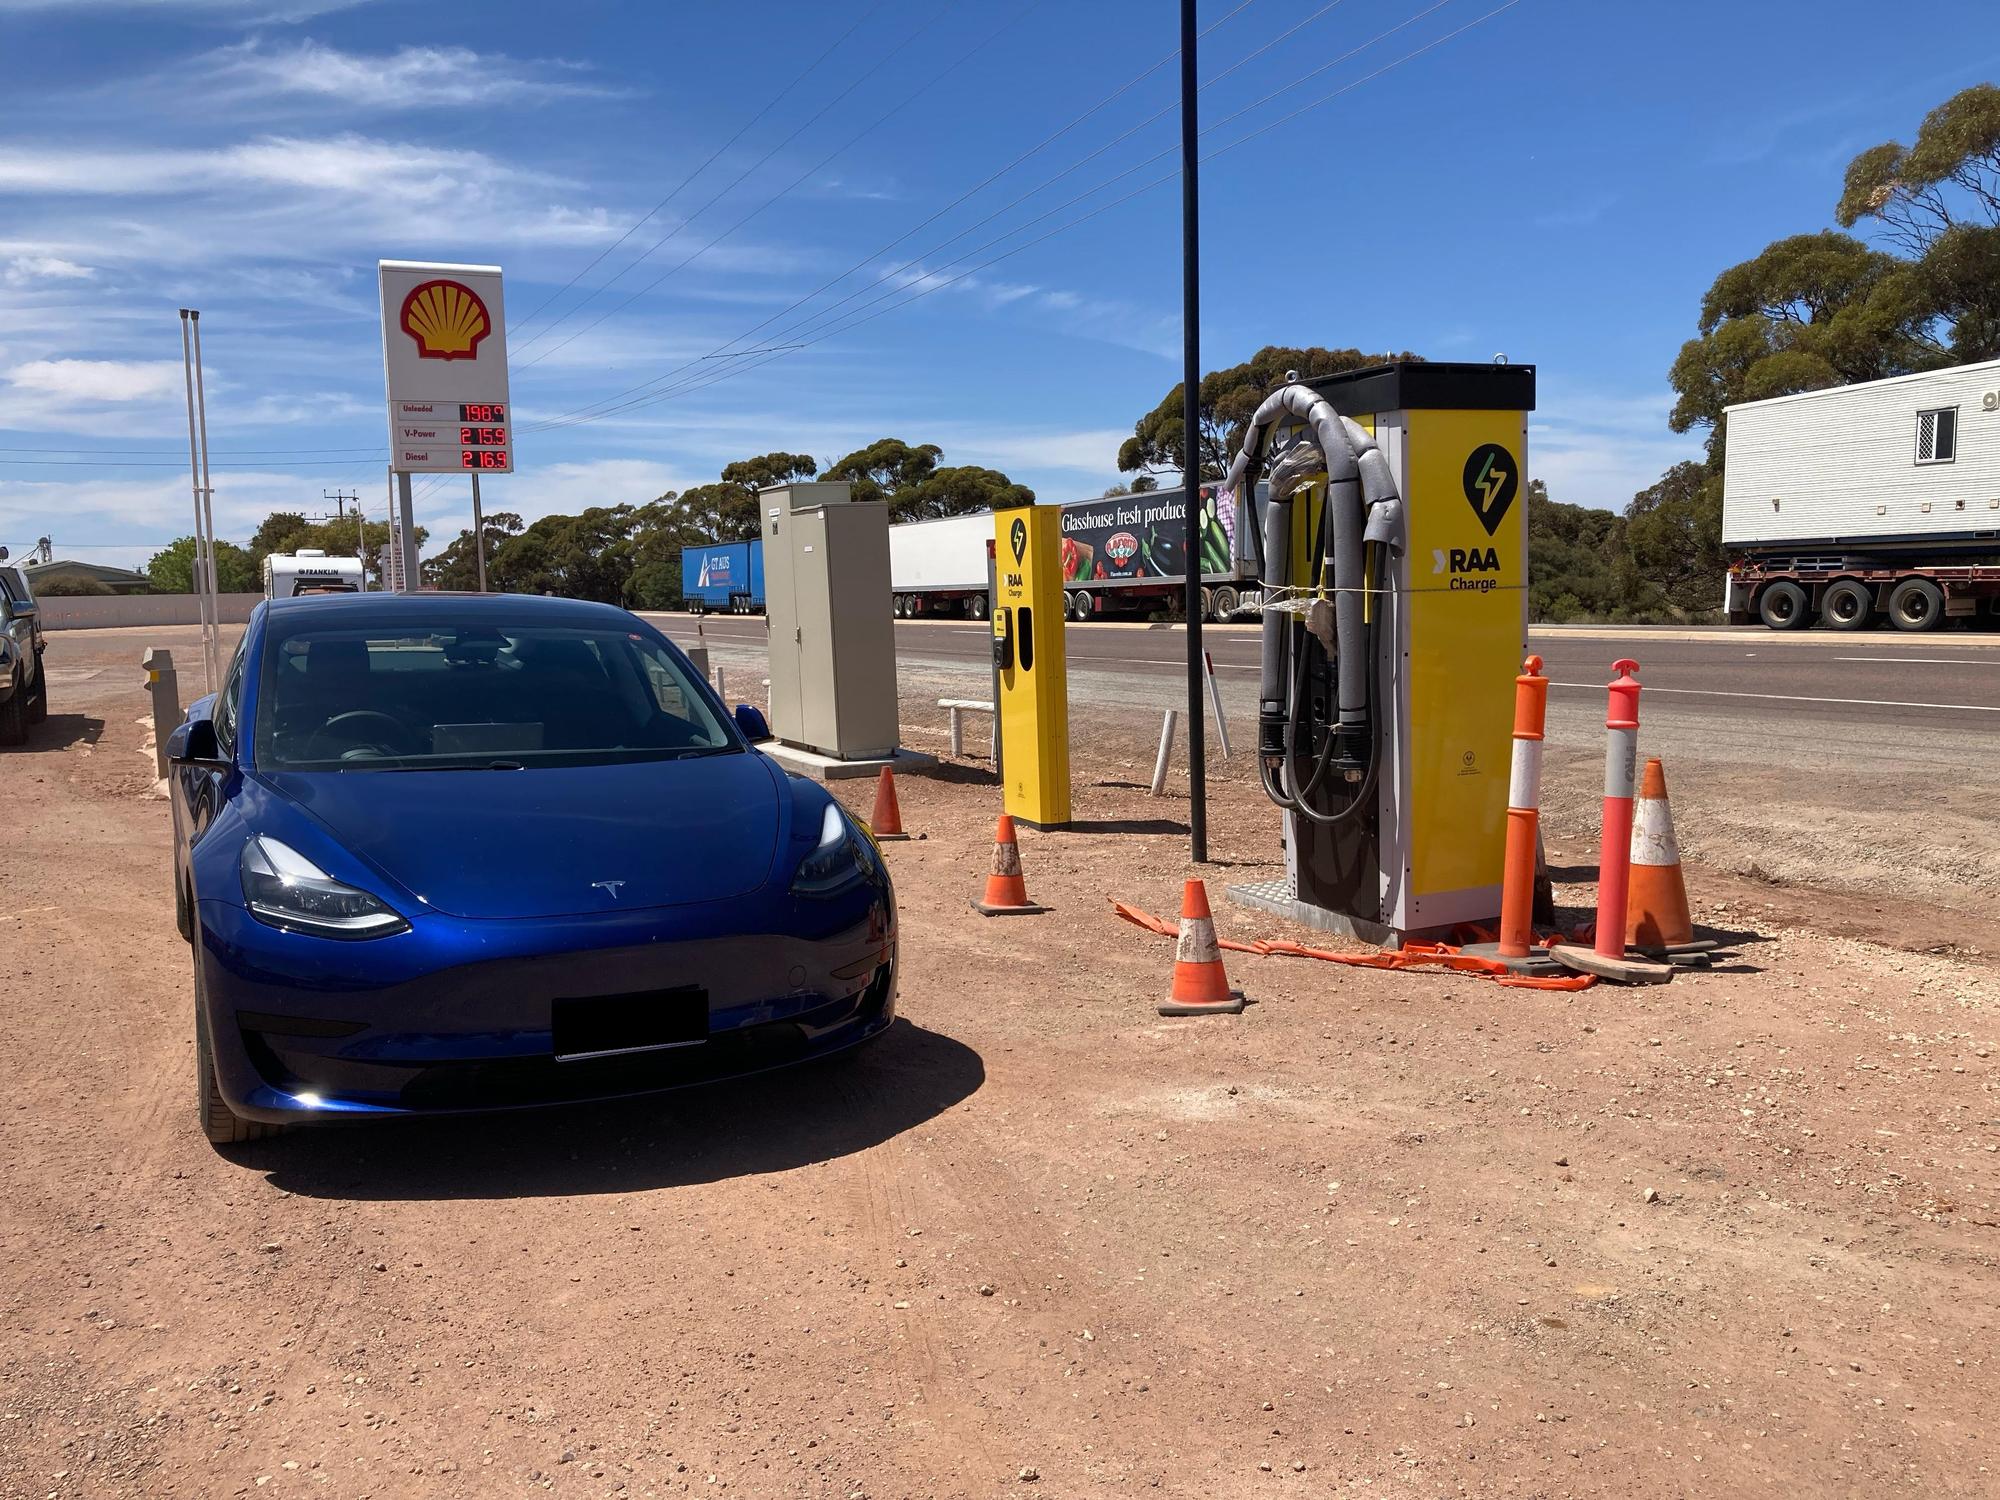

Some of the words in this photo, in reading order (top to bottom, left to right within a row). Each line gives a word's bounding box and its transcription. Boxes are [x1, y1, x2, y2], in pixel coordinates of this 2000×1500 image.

[403, 405, 433, 413] Unleaded
[404, 429, 436, 438] V-Power
[405, 452, 428, 461] Diesel
[1062, 511, 1114, 532] Glasshouse
[1117, 504, 1141, 526] fresh
[1450, 548, 1501, 573] RAA
[1008, 574, 1023, 587] RAA
[1450, 577, 1497, 593] Charge
